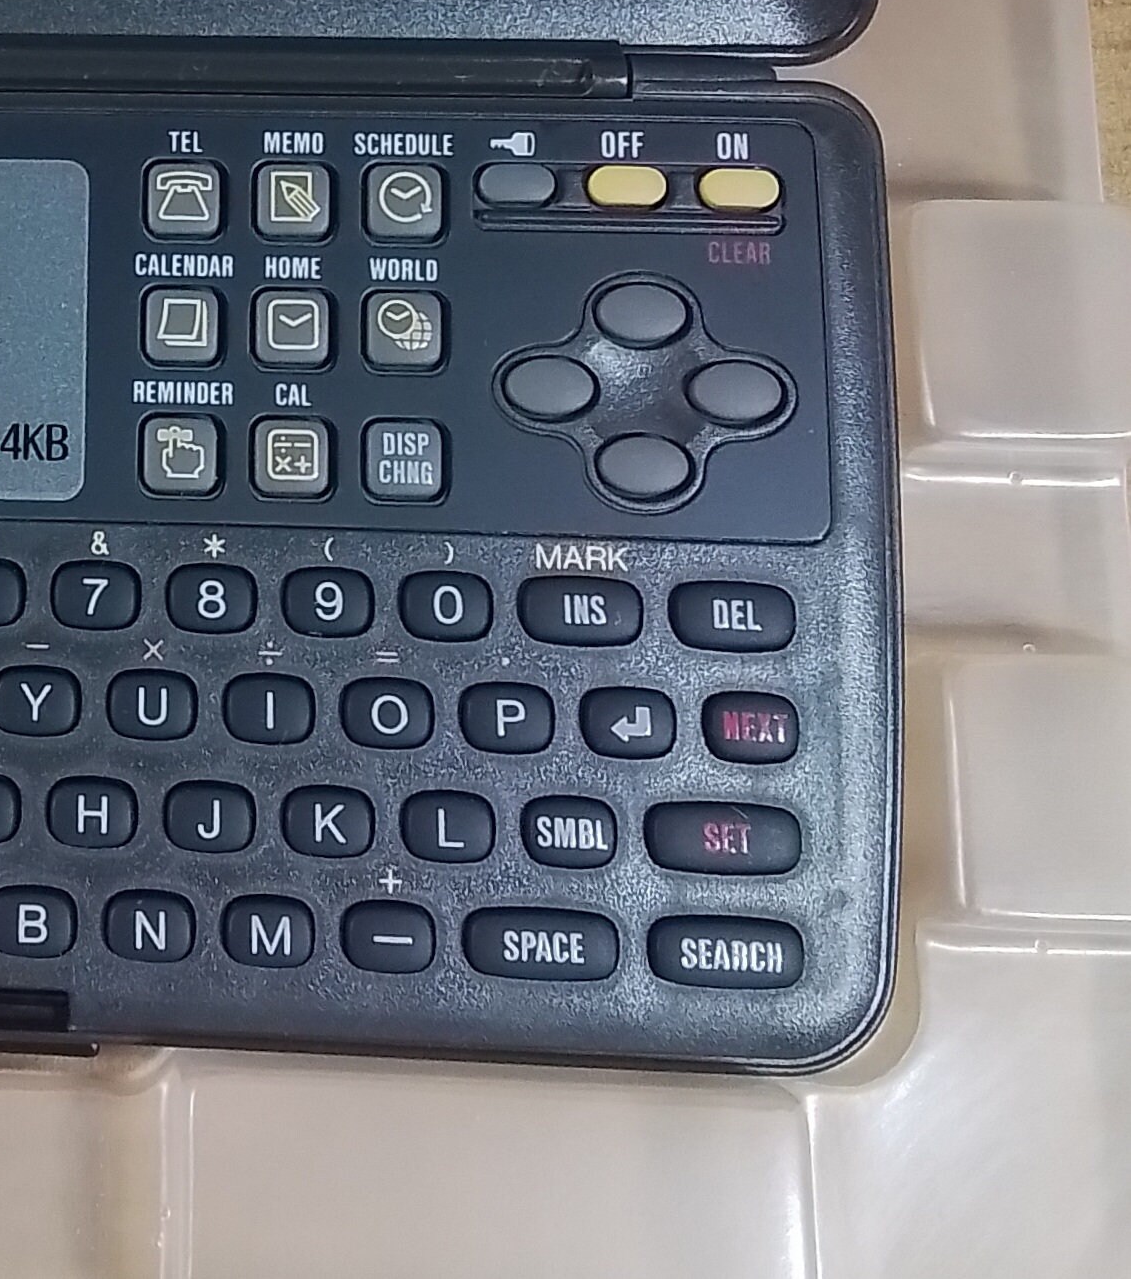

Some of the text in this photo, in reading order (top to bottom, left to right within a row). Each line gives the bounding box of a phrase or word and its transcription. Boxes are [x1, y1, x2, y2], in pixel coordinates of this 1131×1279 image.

[169, 132, 202, 152] TEL
[264, 132, 323, 153] MEMO
[355, 133, 453, 155] SCHEDULE
[602, 132, 643, 157] OFF
[717, 133, 748, 159] ON
[136, 254, 233, 276] CALENDAR
[707, 241, 771, 266] CLEAR
[266, 257, 320, 279] HOME
[370, 258, 437, 281] WORLD
[134, 381, 232, 404] REMINDER
[276, 384, 311, 406] CAL
[382, 432, 429, 456] DISP
[378, 461, 433, 486] CHNG
[534, 544, 629, 570] MARK
[563, 595, 607, 625] INS
[713, 600, 762, 631] DEL
[722, 711, 789, 743] NEXT
[537, 816, 608, 851] SMBL
[702, 823, 751, 855] SET
[503, 931, 585, 964] SPACE
[680, 939, 783, 974] SEARCH
